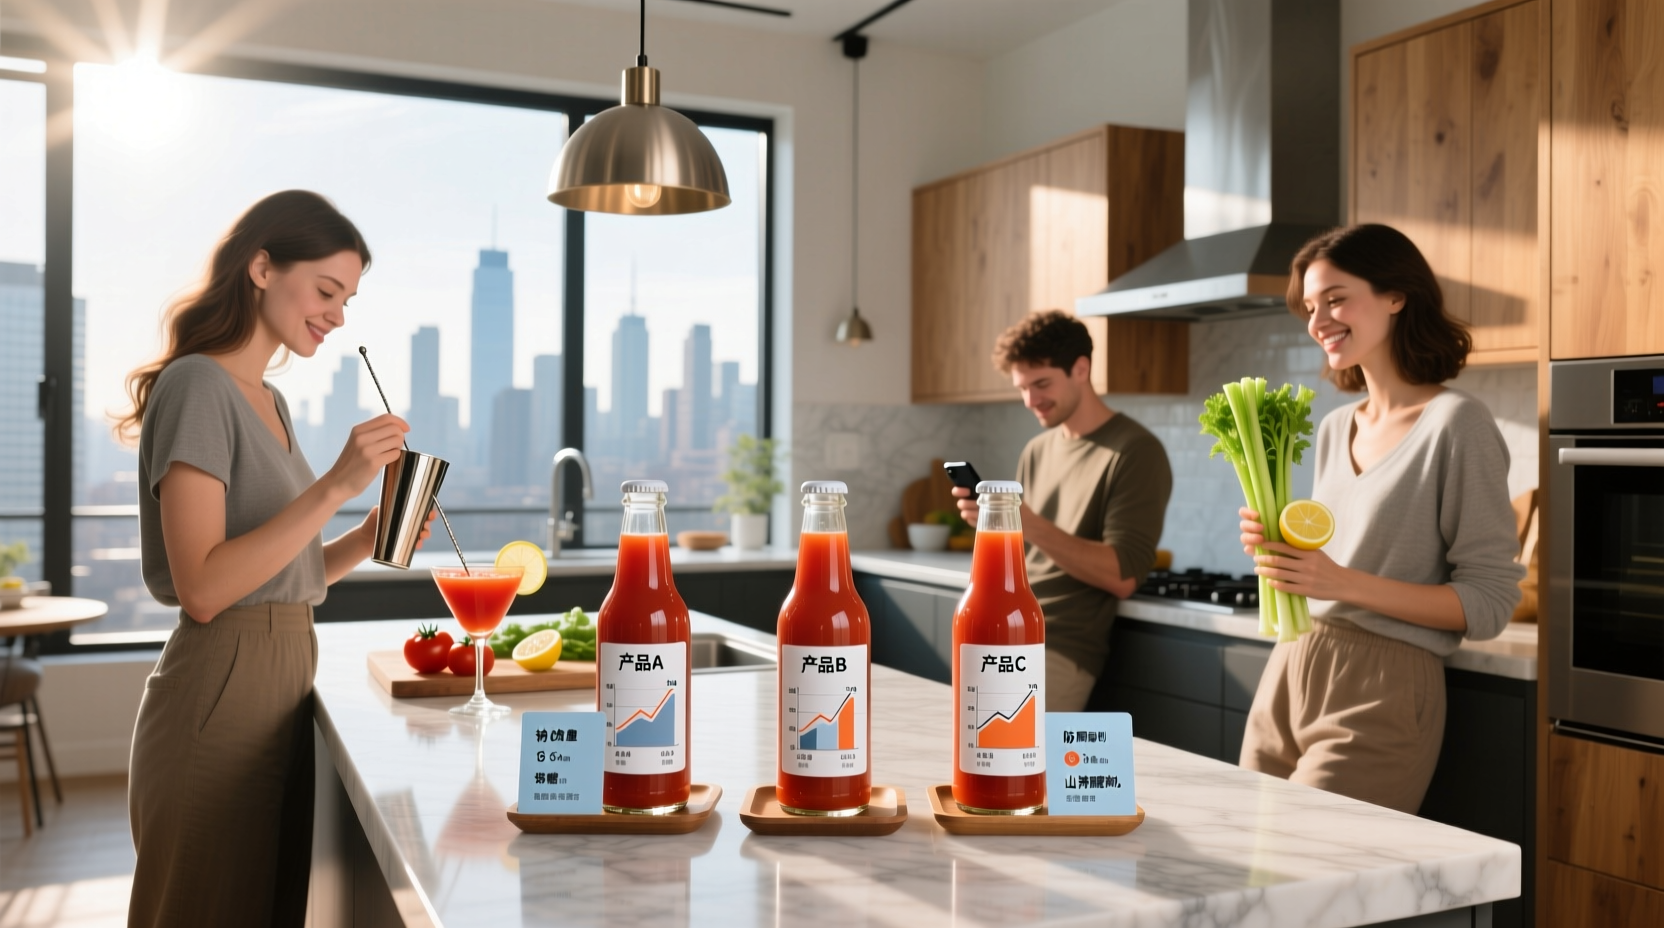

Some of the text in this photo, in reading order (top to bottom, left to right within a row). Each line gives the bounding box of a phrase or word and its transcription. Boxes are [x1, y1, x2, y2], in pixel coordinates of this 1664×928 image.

[618, 652, 664, 672] 产品A
[801, 654, 847, 674] 产品B
[980, 654, 1026, 673] 产品C
